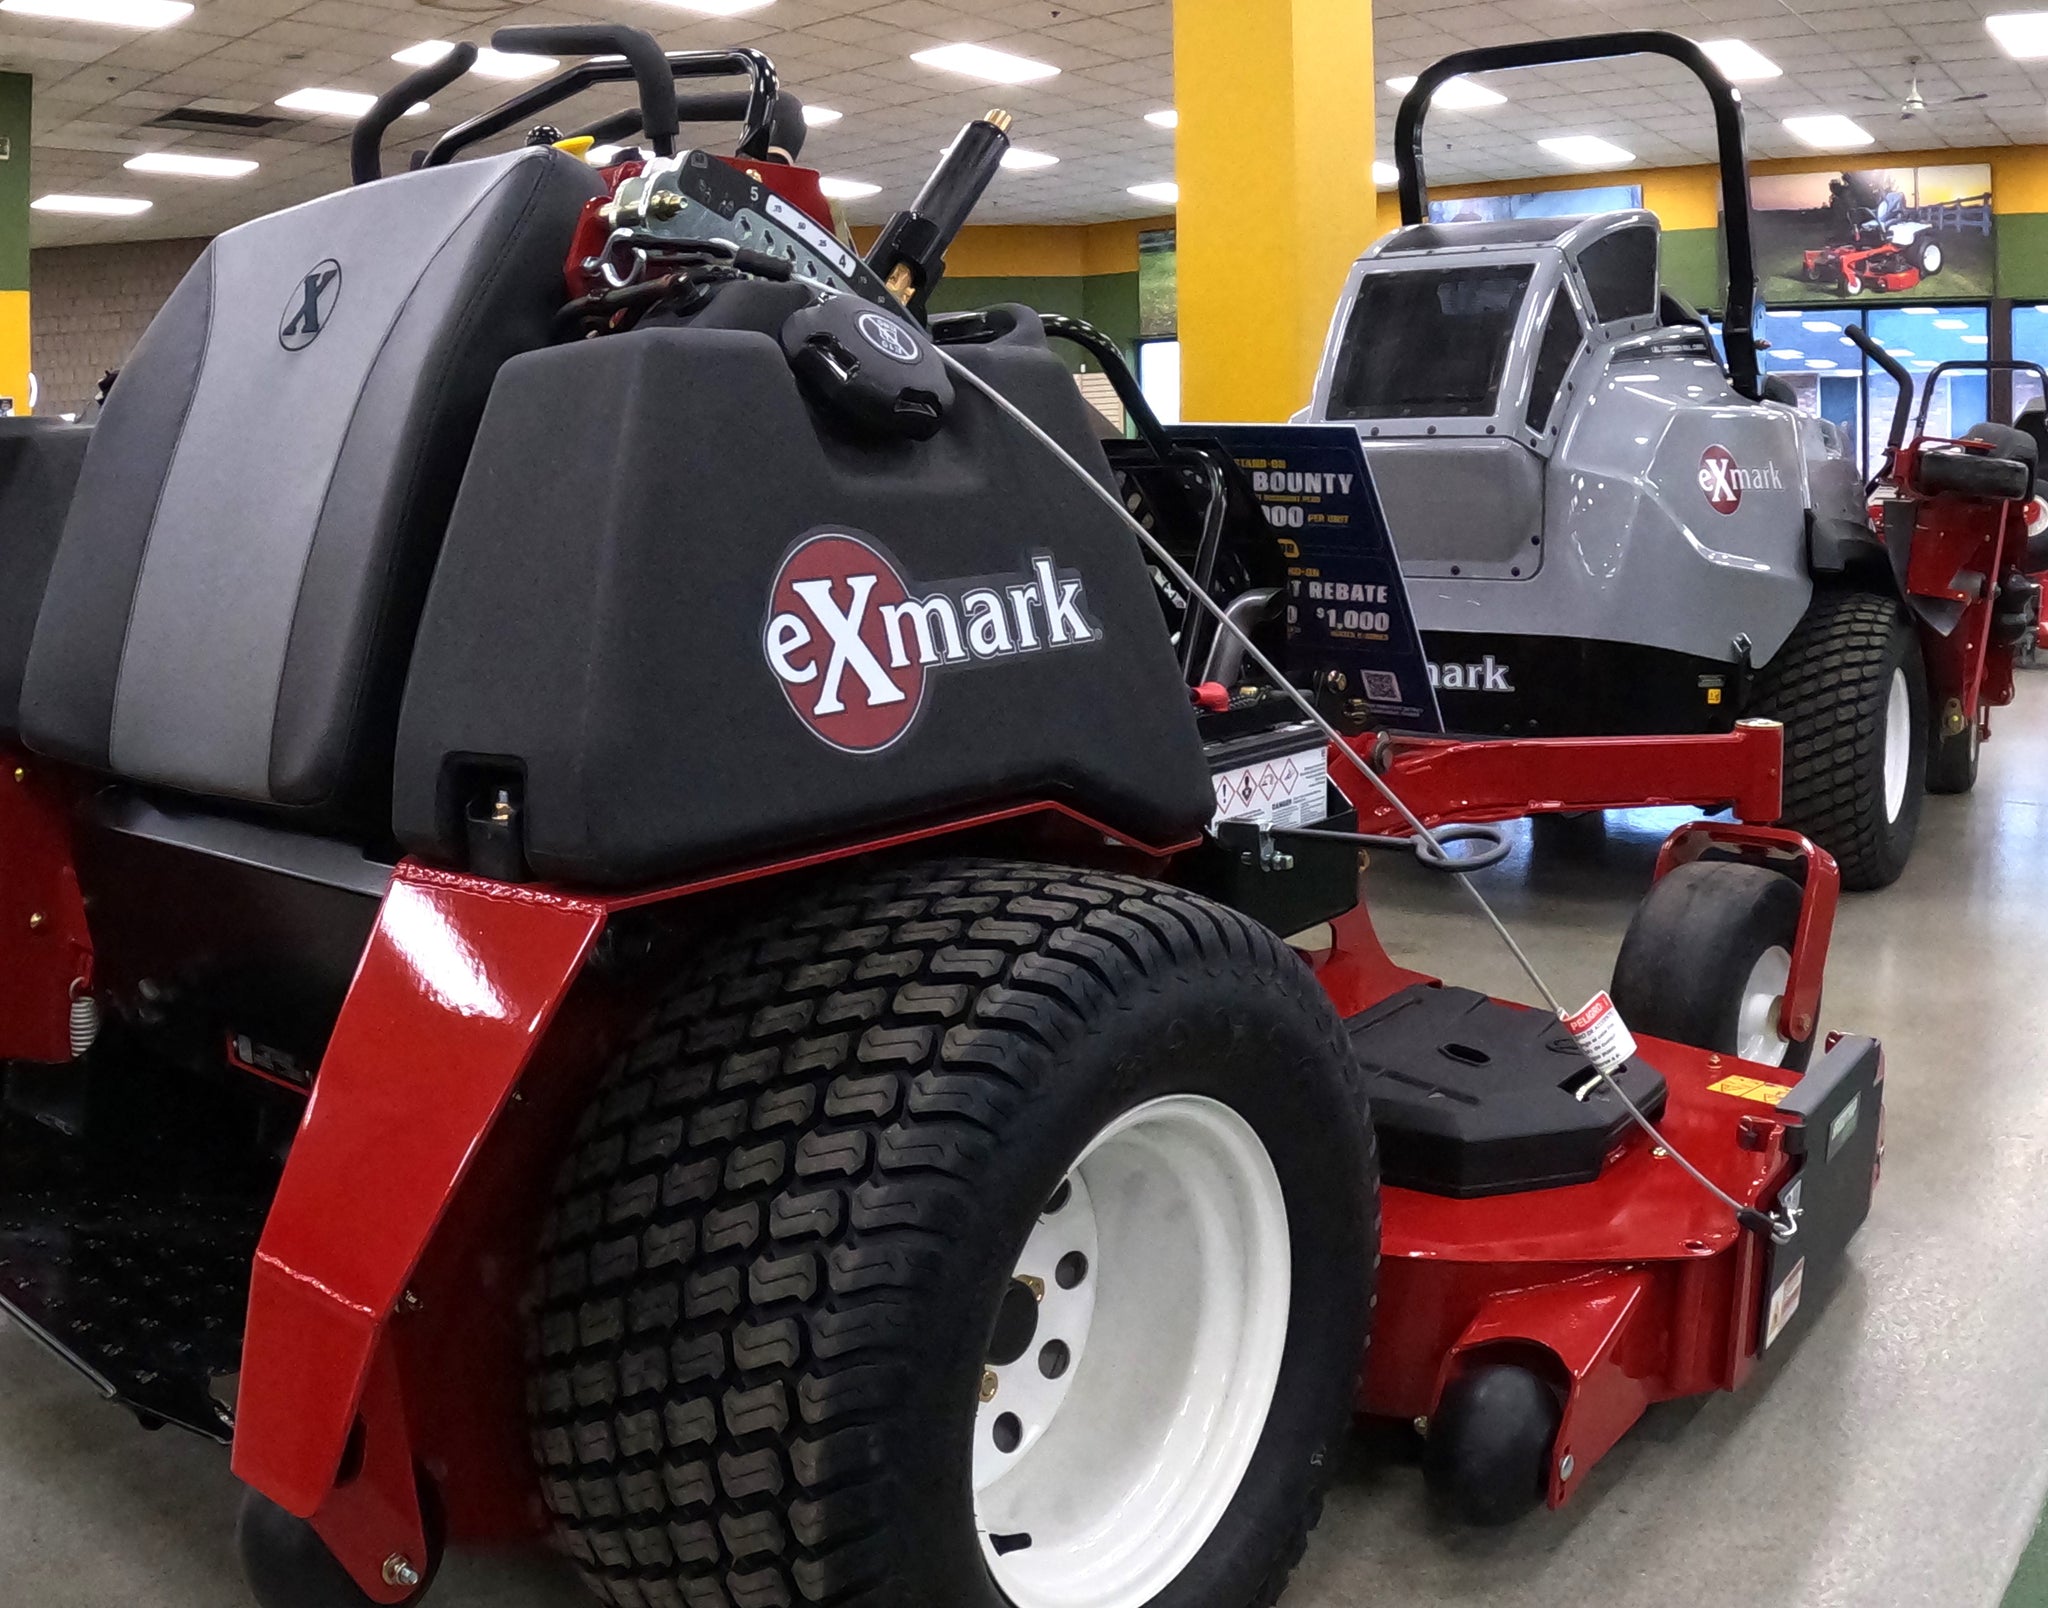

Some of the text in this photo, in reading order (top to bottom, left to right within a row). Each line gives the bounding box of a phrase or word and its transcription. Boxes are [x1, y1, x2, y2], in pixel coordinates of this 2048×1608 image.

[750, 186, 760, 201] 5
[838, 254, 847, 269] 4
[282, 269, 338, 336] X
[1252, 471, 1354, 494] BOUNTY
[1698, 458, 1785, 502] eXmark
[1308, 581, 1389, 603] REBATE
[765, 556, 1094, 716] eXmark
[1316, 607, 1390, 632] $1,000
[1570, 1002, 1603, 1031] PELIGRO
